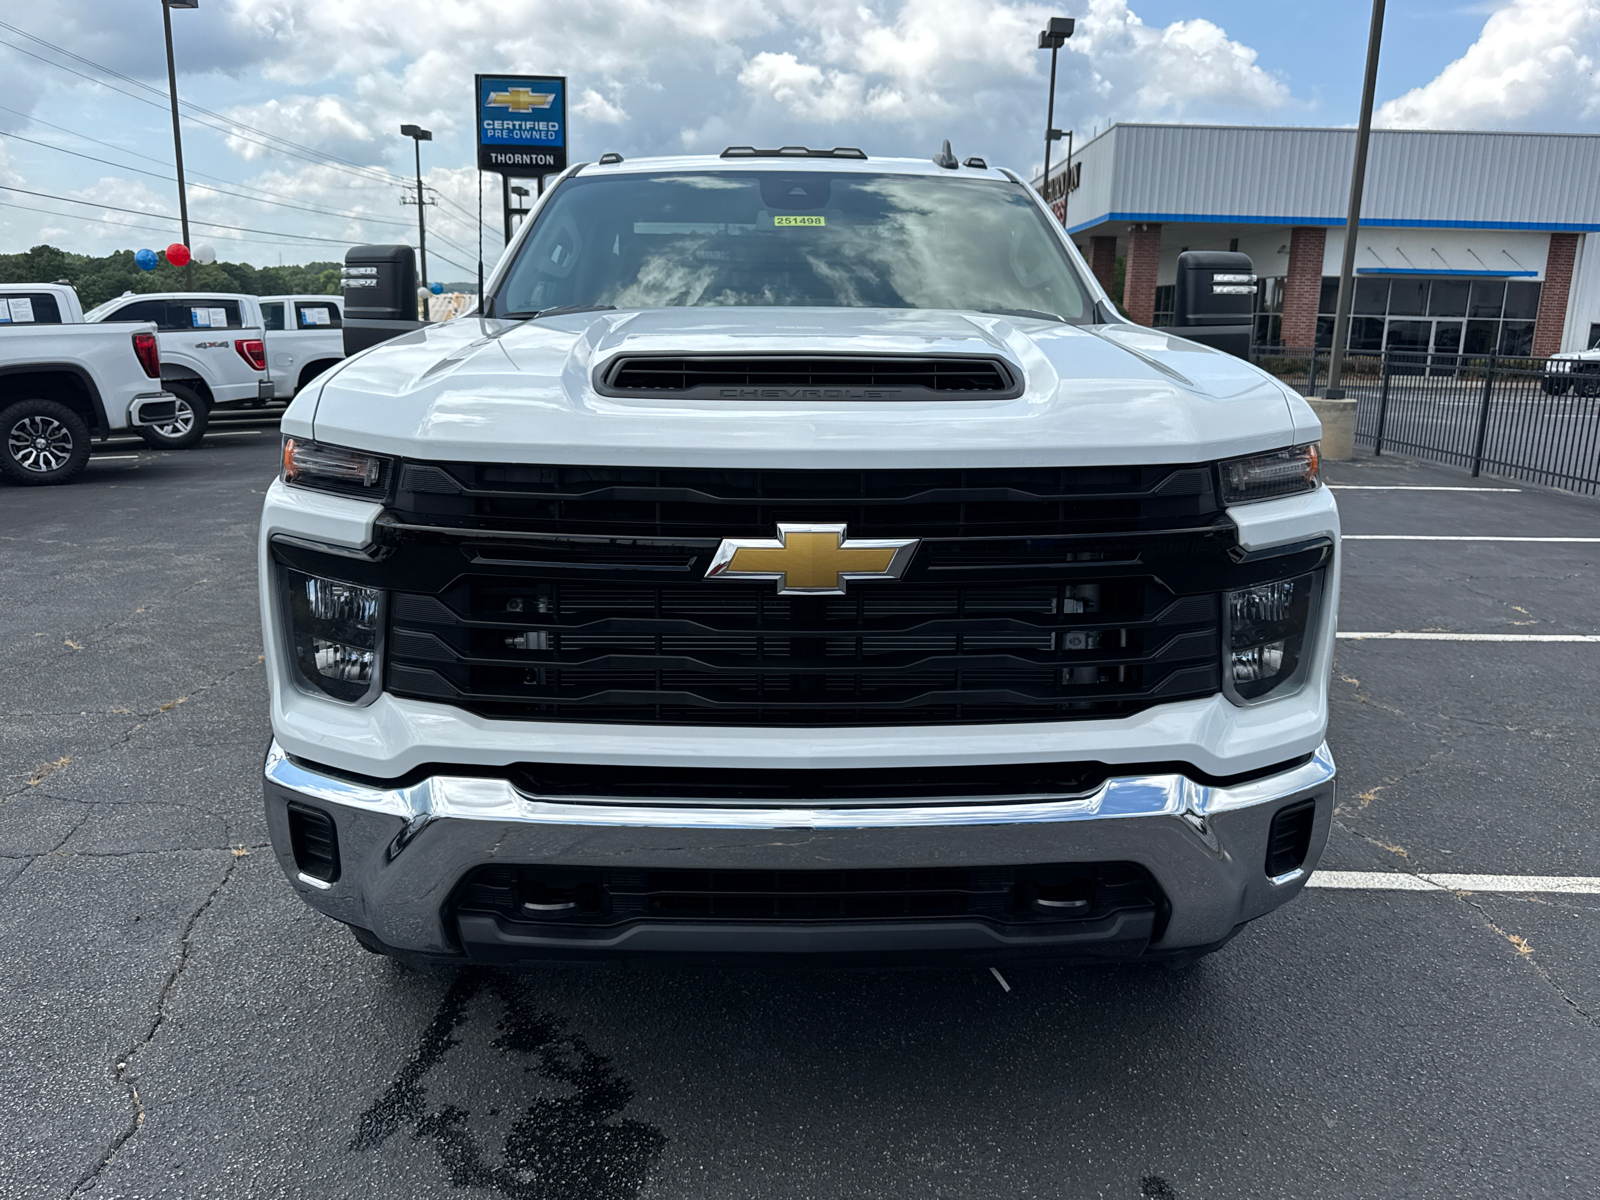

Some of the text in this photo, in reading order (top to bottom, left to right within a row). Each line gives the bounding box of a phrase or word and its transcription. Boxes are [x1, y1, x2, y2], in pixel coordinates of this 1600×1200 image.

[483, 120, 559, 131] CERTIFIED
[487, 129, 556, 140] PRE-OWNED
[490, 153, 554, 165] THORNTON
[776, 217, 822, 225] 251498
[719, 389, 902, 398] CHEVROLET
